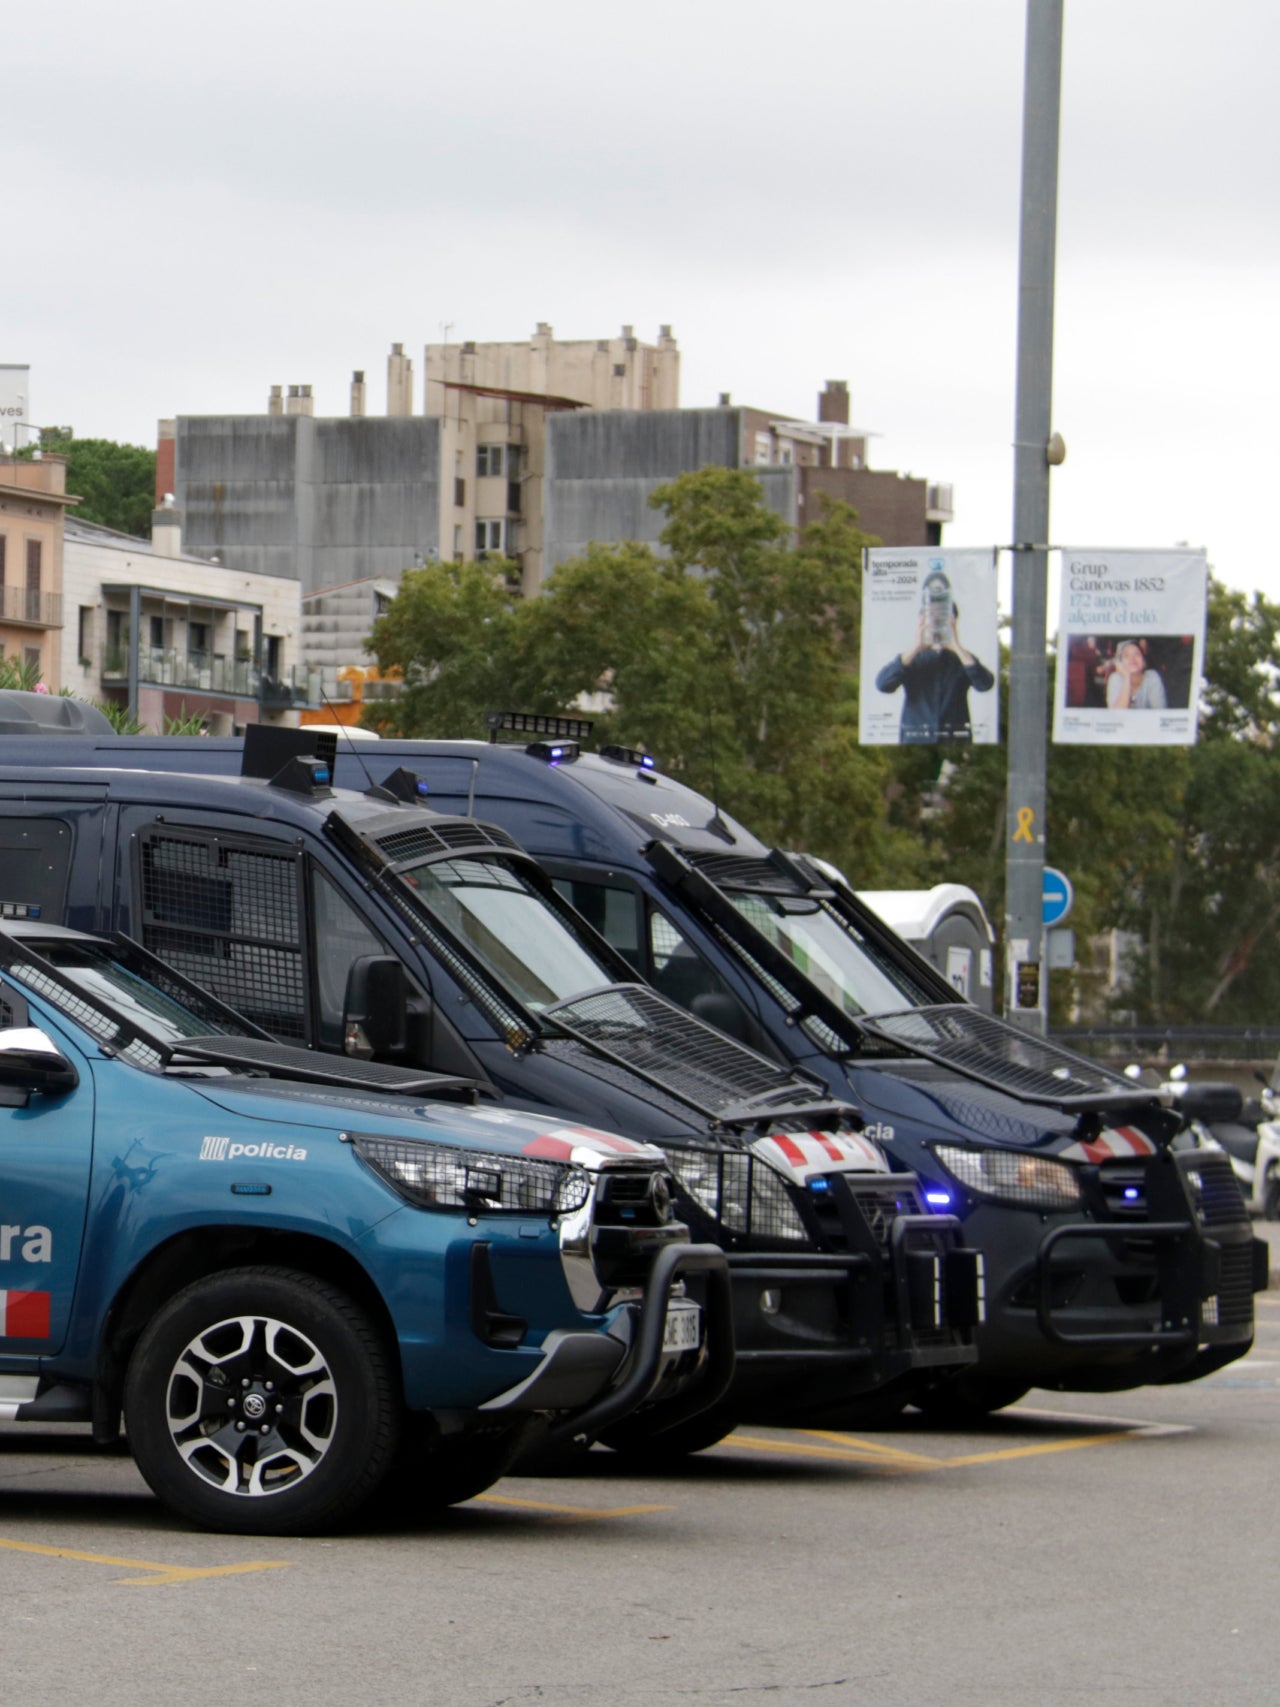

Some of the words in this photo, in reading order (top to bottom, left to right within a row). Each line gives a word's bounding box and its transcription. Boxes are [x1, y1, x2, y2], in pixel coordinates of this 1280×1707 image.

[1069, 561, 1108, 578] Grup
[1133, 576, 1166, 592] 1852
[1093, 594, 1128, 611] anys
[1114, 608, 1127, 624] el
[228, 1142, 308, 1161] policia
